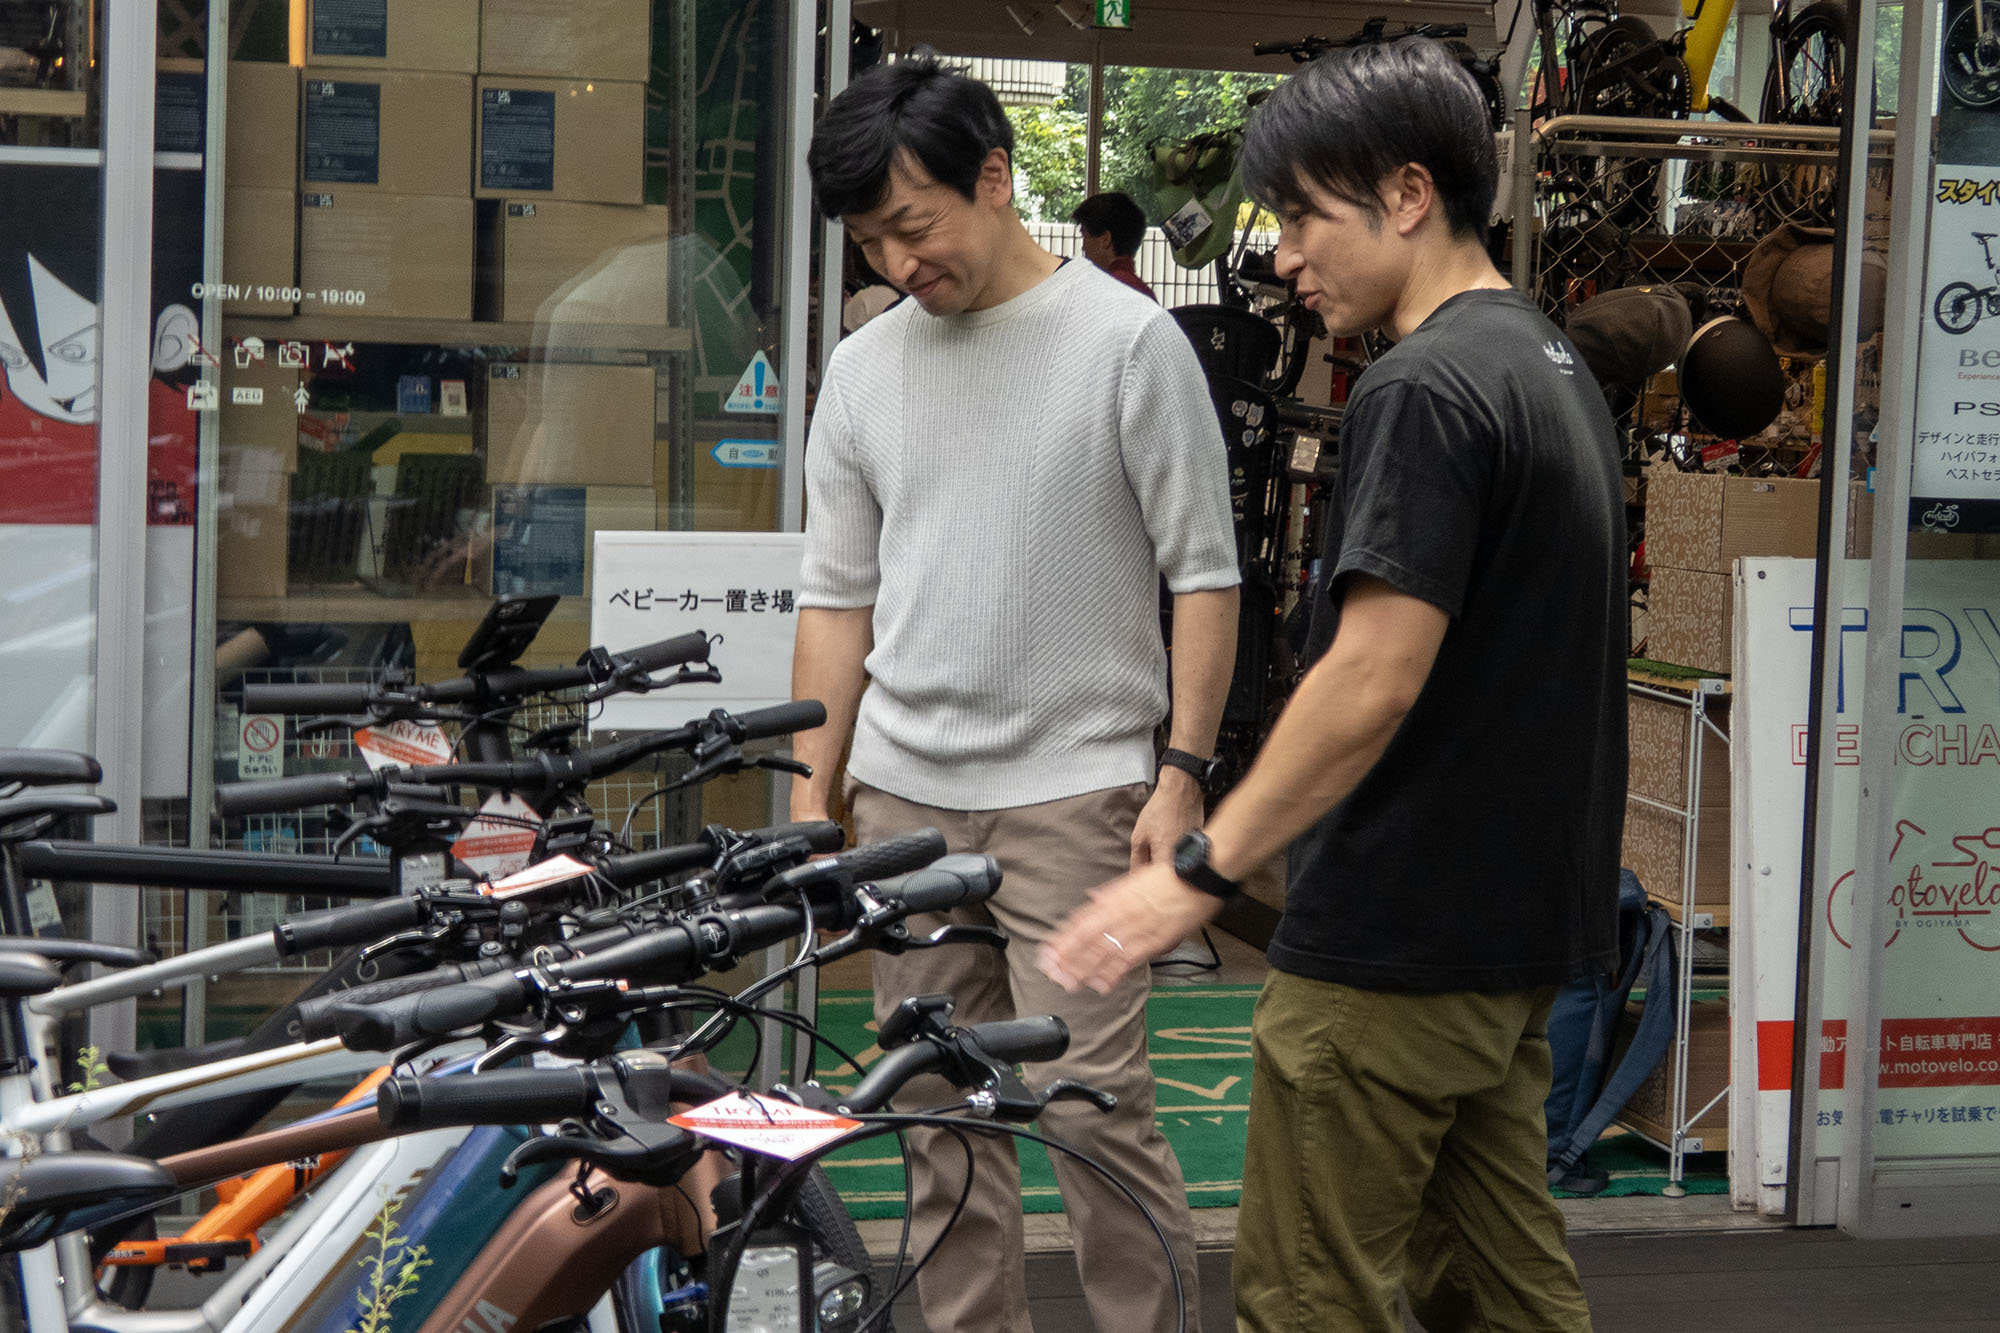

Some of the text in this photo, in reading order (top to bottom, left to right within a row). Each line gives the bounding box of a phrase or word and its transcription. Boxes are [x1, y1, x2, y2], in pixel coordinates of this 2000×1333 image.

[191, 283, 240, 299] OPEN
[256, 286, 302, 303] 10:00
[321, 289, 366, 305] 19:00
[236, 390, 261, 400] AED
[1919, 431, 2000, 446] デザインと走行
[609, 587, 796, 613] ベビーカー置き場
[1886, 861, 2000, 907] otovelo
[1895, 919, 1971, 928] BY OGIYAMA
